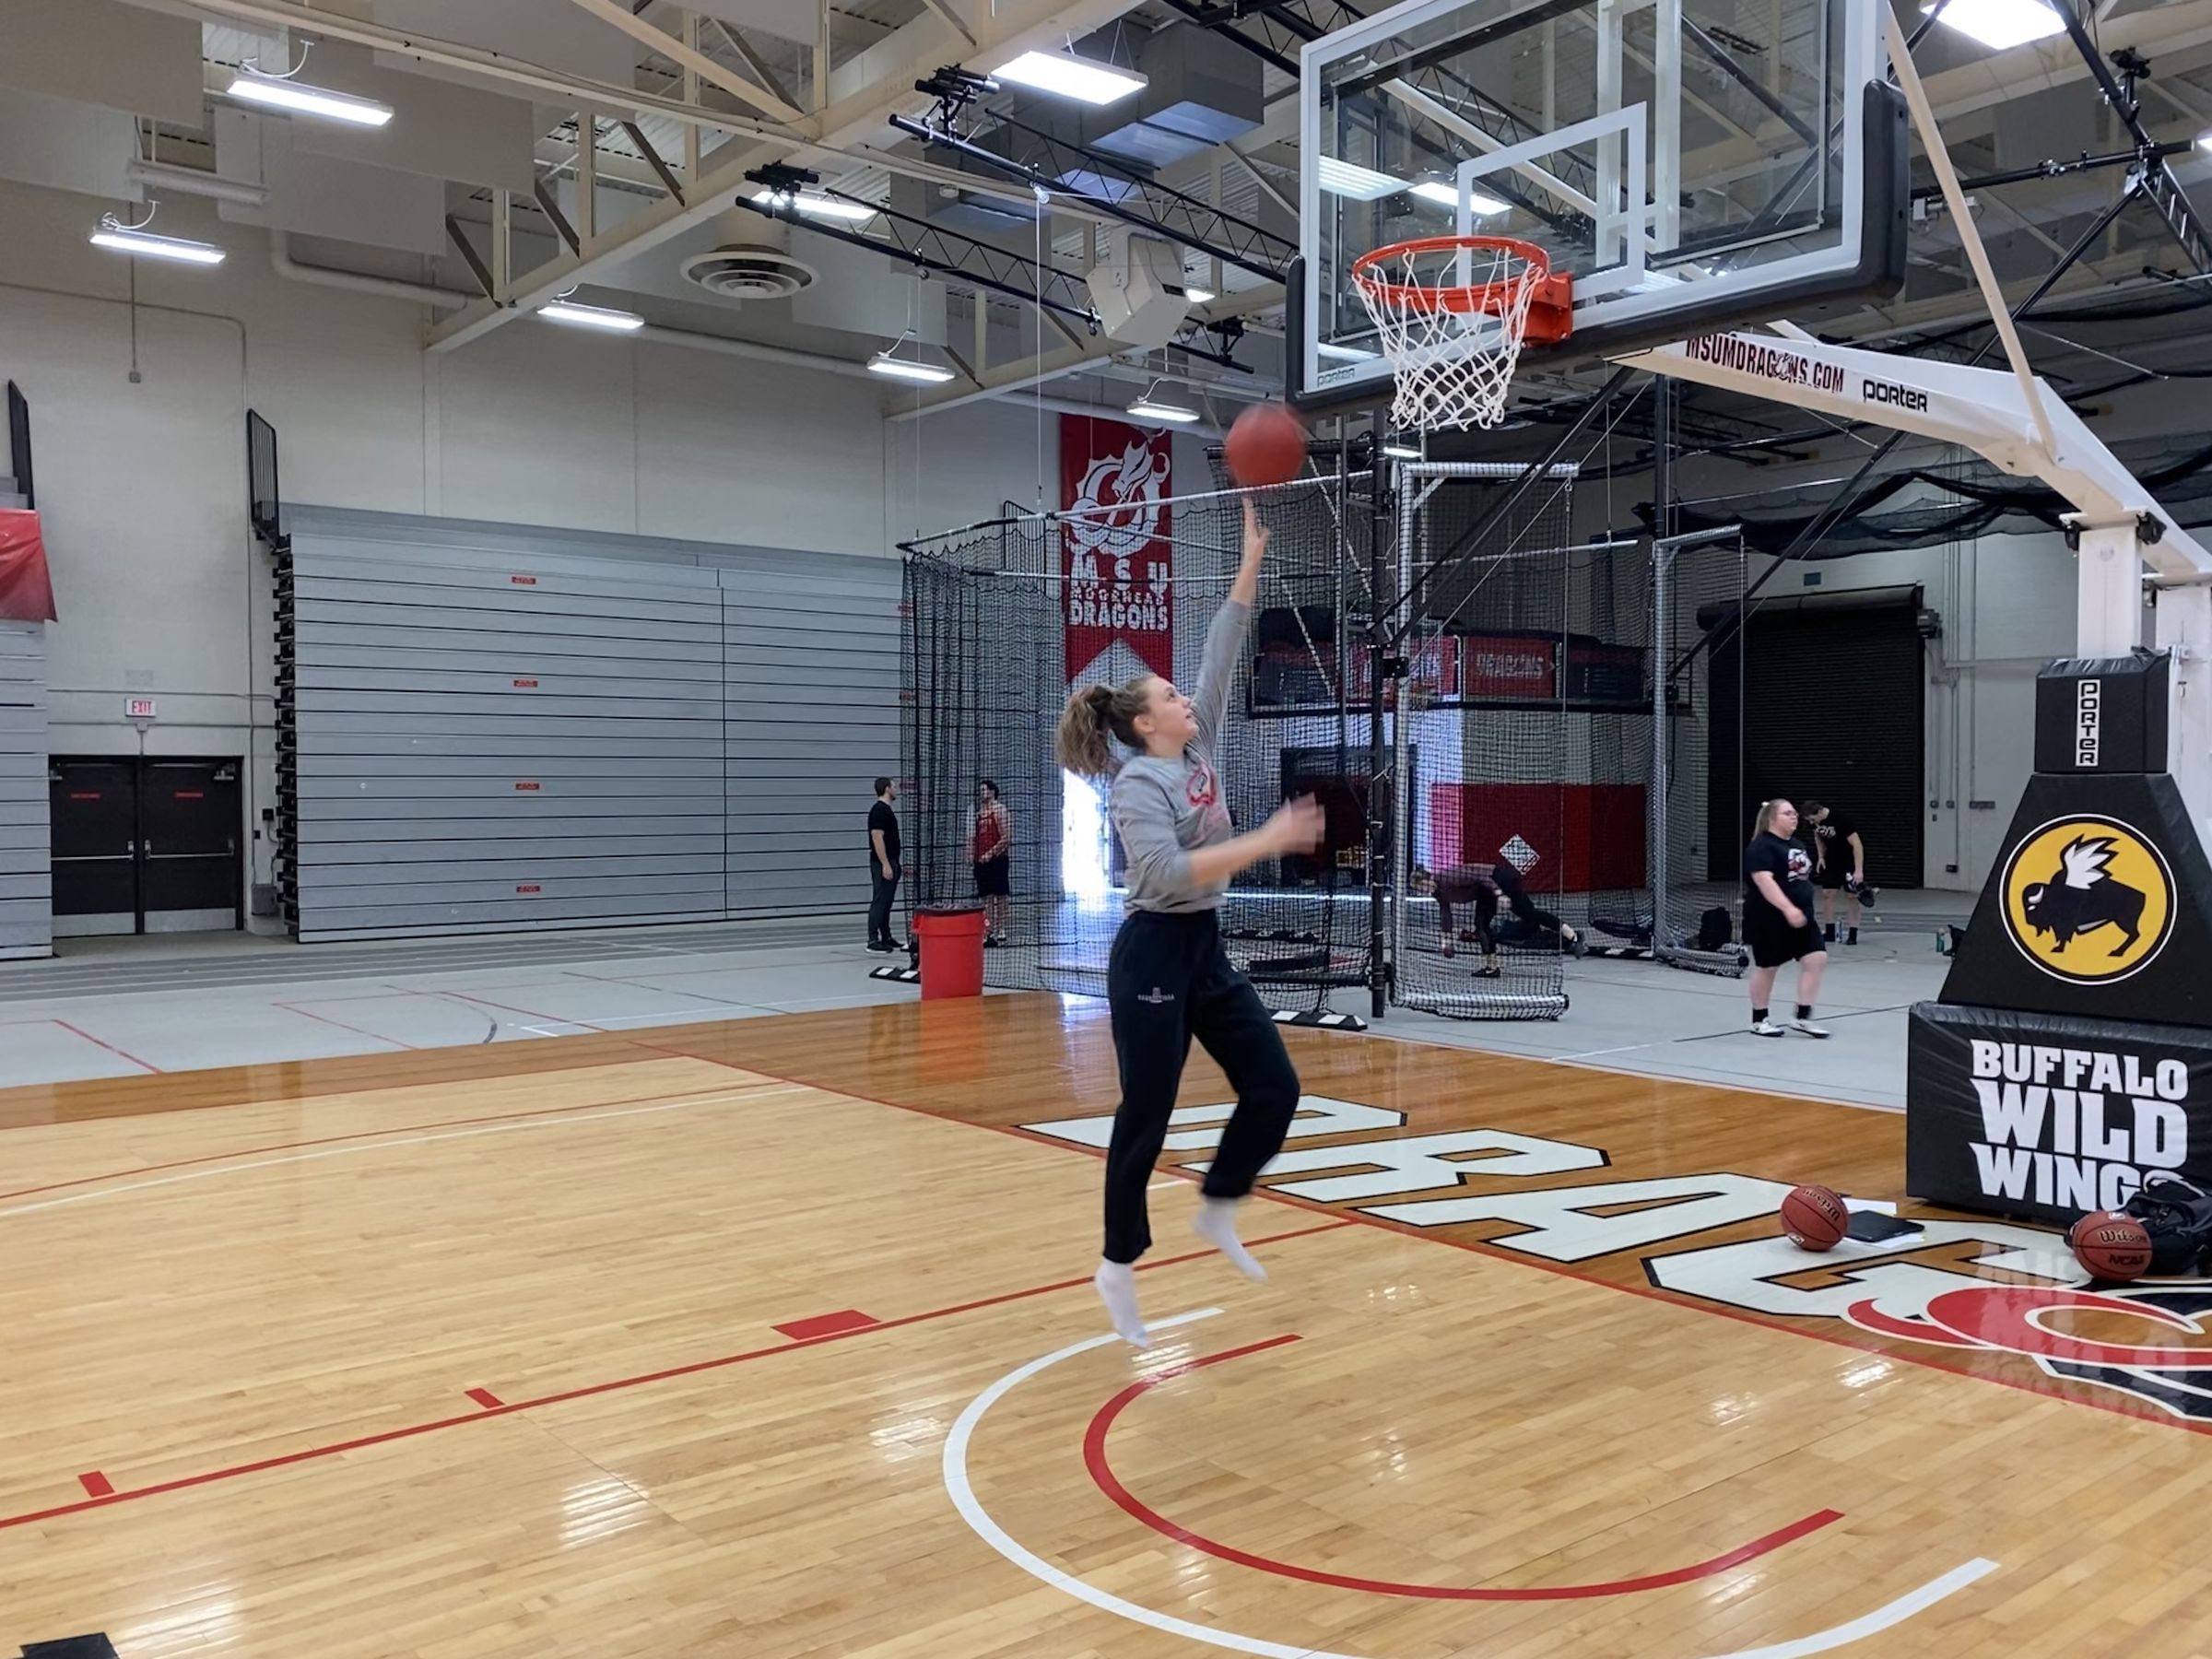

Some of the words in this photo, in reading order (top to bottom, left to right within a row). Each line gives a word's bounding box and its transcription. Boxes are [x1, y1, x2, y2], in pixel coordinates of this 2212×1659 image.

[1069, 599, 1169, 631] DRAGONS
[132, 700, 151, 714] EXIT
[1970, 1039, 2189, 1101] BUFFALO
[1969, 1077, 2188, 1170] WILD
